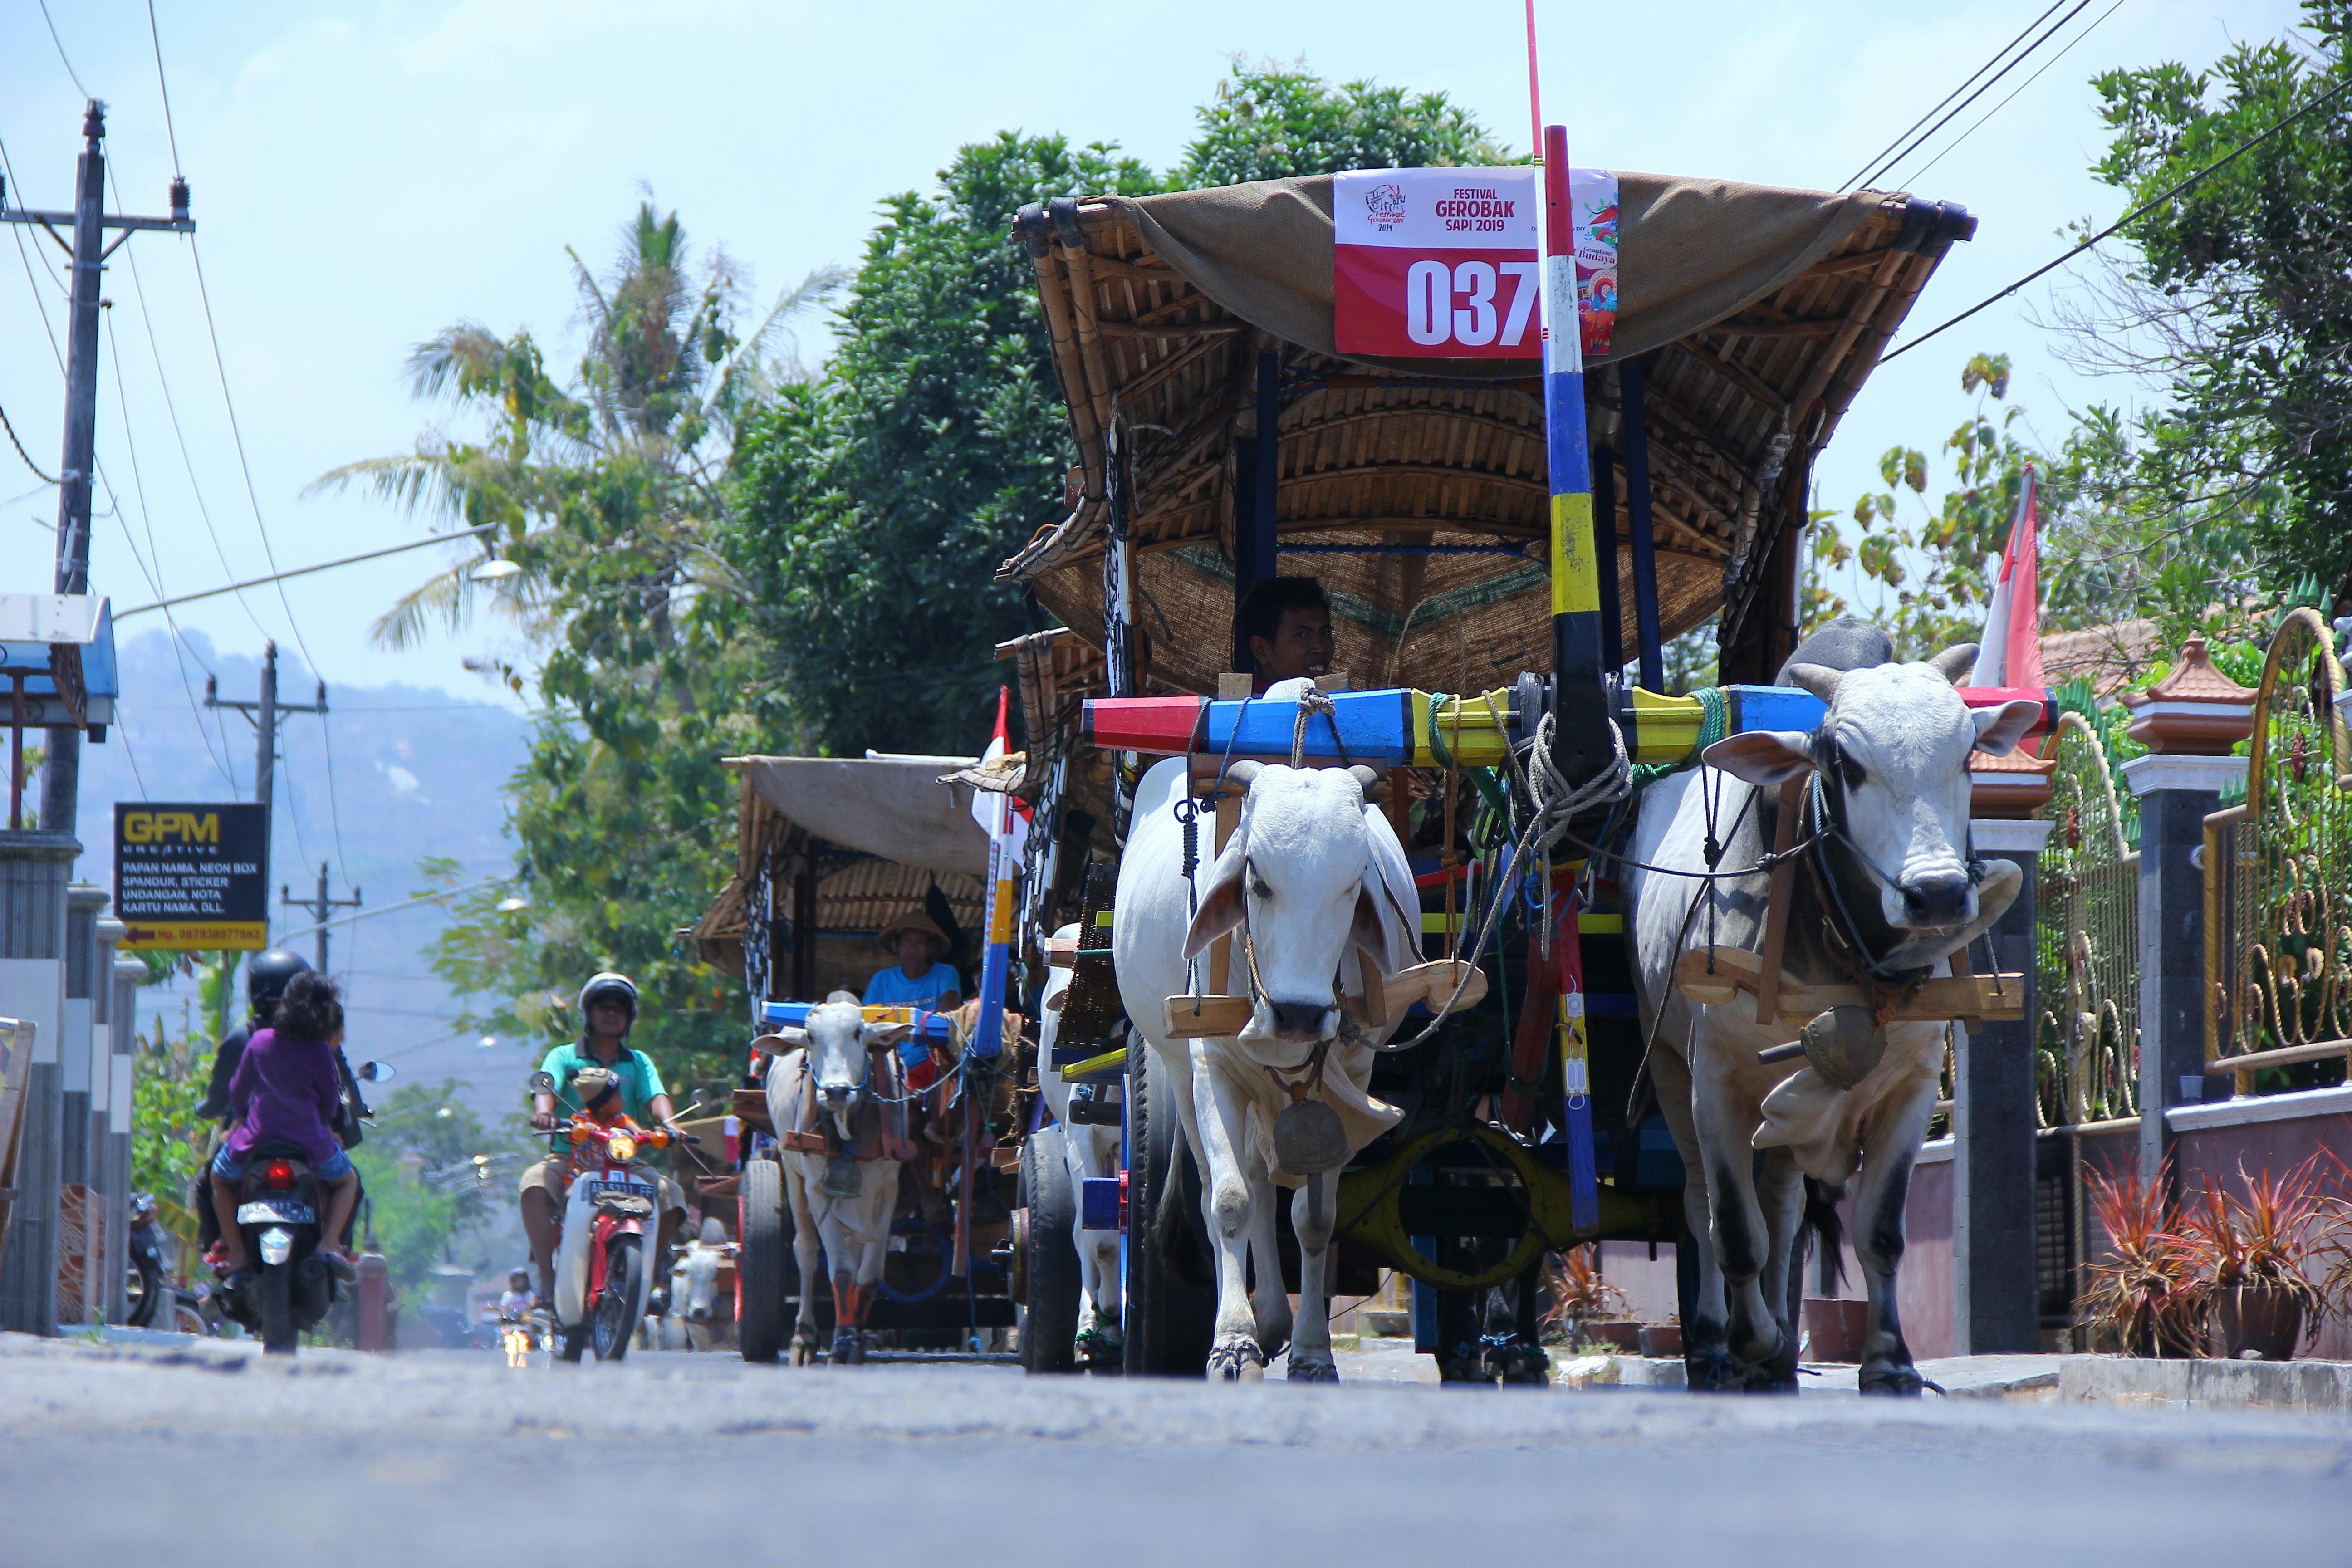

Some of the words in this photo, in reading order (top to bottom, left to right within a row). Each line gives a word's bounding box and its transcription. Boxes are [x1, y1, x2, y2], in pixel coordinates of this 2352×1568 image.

[1454, 189, 1498, 199] FESTIVAL
[1375, 210, 1406, 218] Festival
[1436, 200, 1515, 217] GEROBAK
[1378, 223, 1393, 231] 2019
[1446, 219, 1472, 231] SAPI
[1476, 219, 1504, 231] 2019
[1579, 250, 1615, 264] Budaya
[1407, 260, 1539, 345] 037
[124, 812, 218, 843] GPM
[123, 862, 158, 873] PAPAN
[200, 863, 230, 874] NEON
[233, 863, 257, 874] BOX
[181, 877, 229, 887] STICKER
[191, 890, 221, 900] NOTA
[122, 902, 160, 913] KARTU
